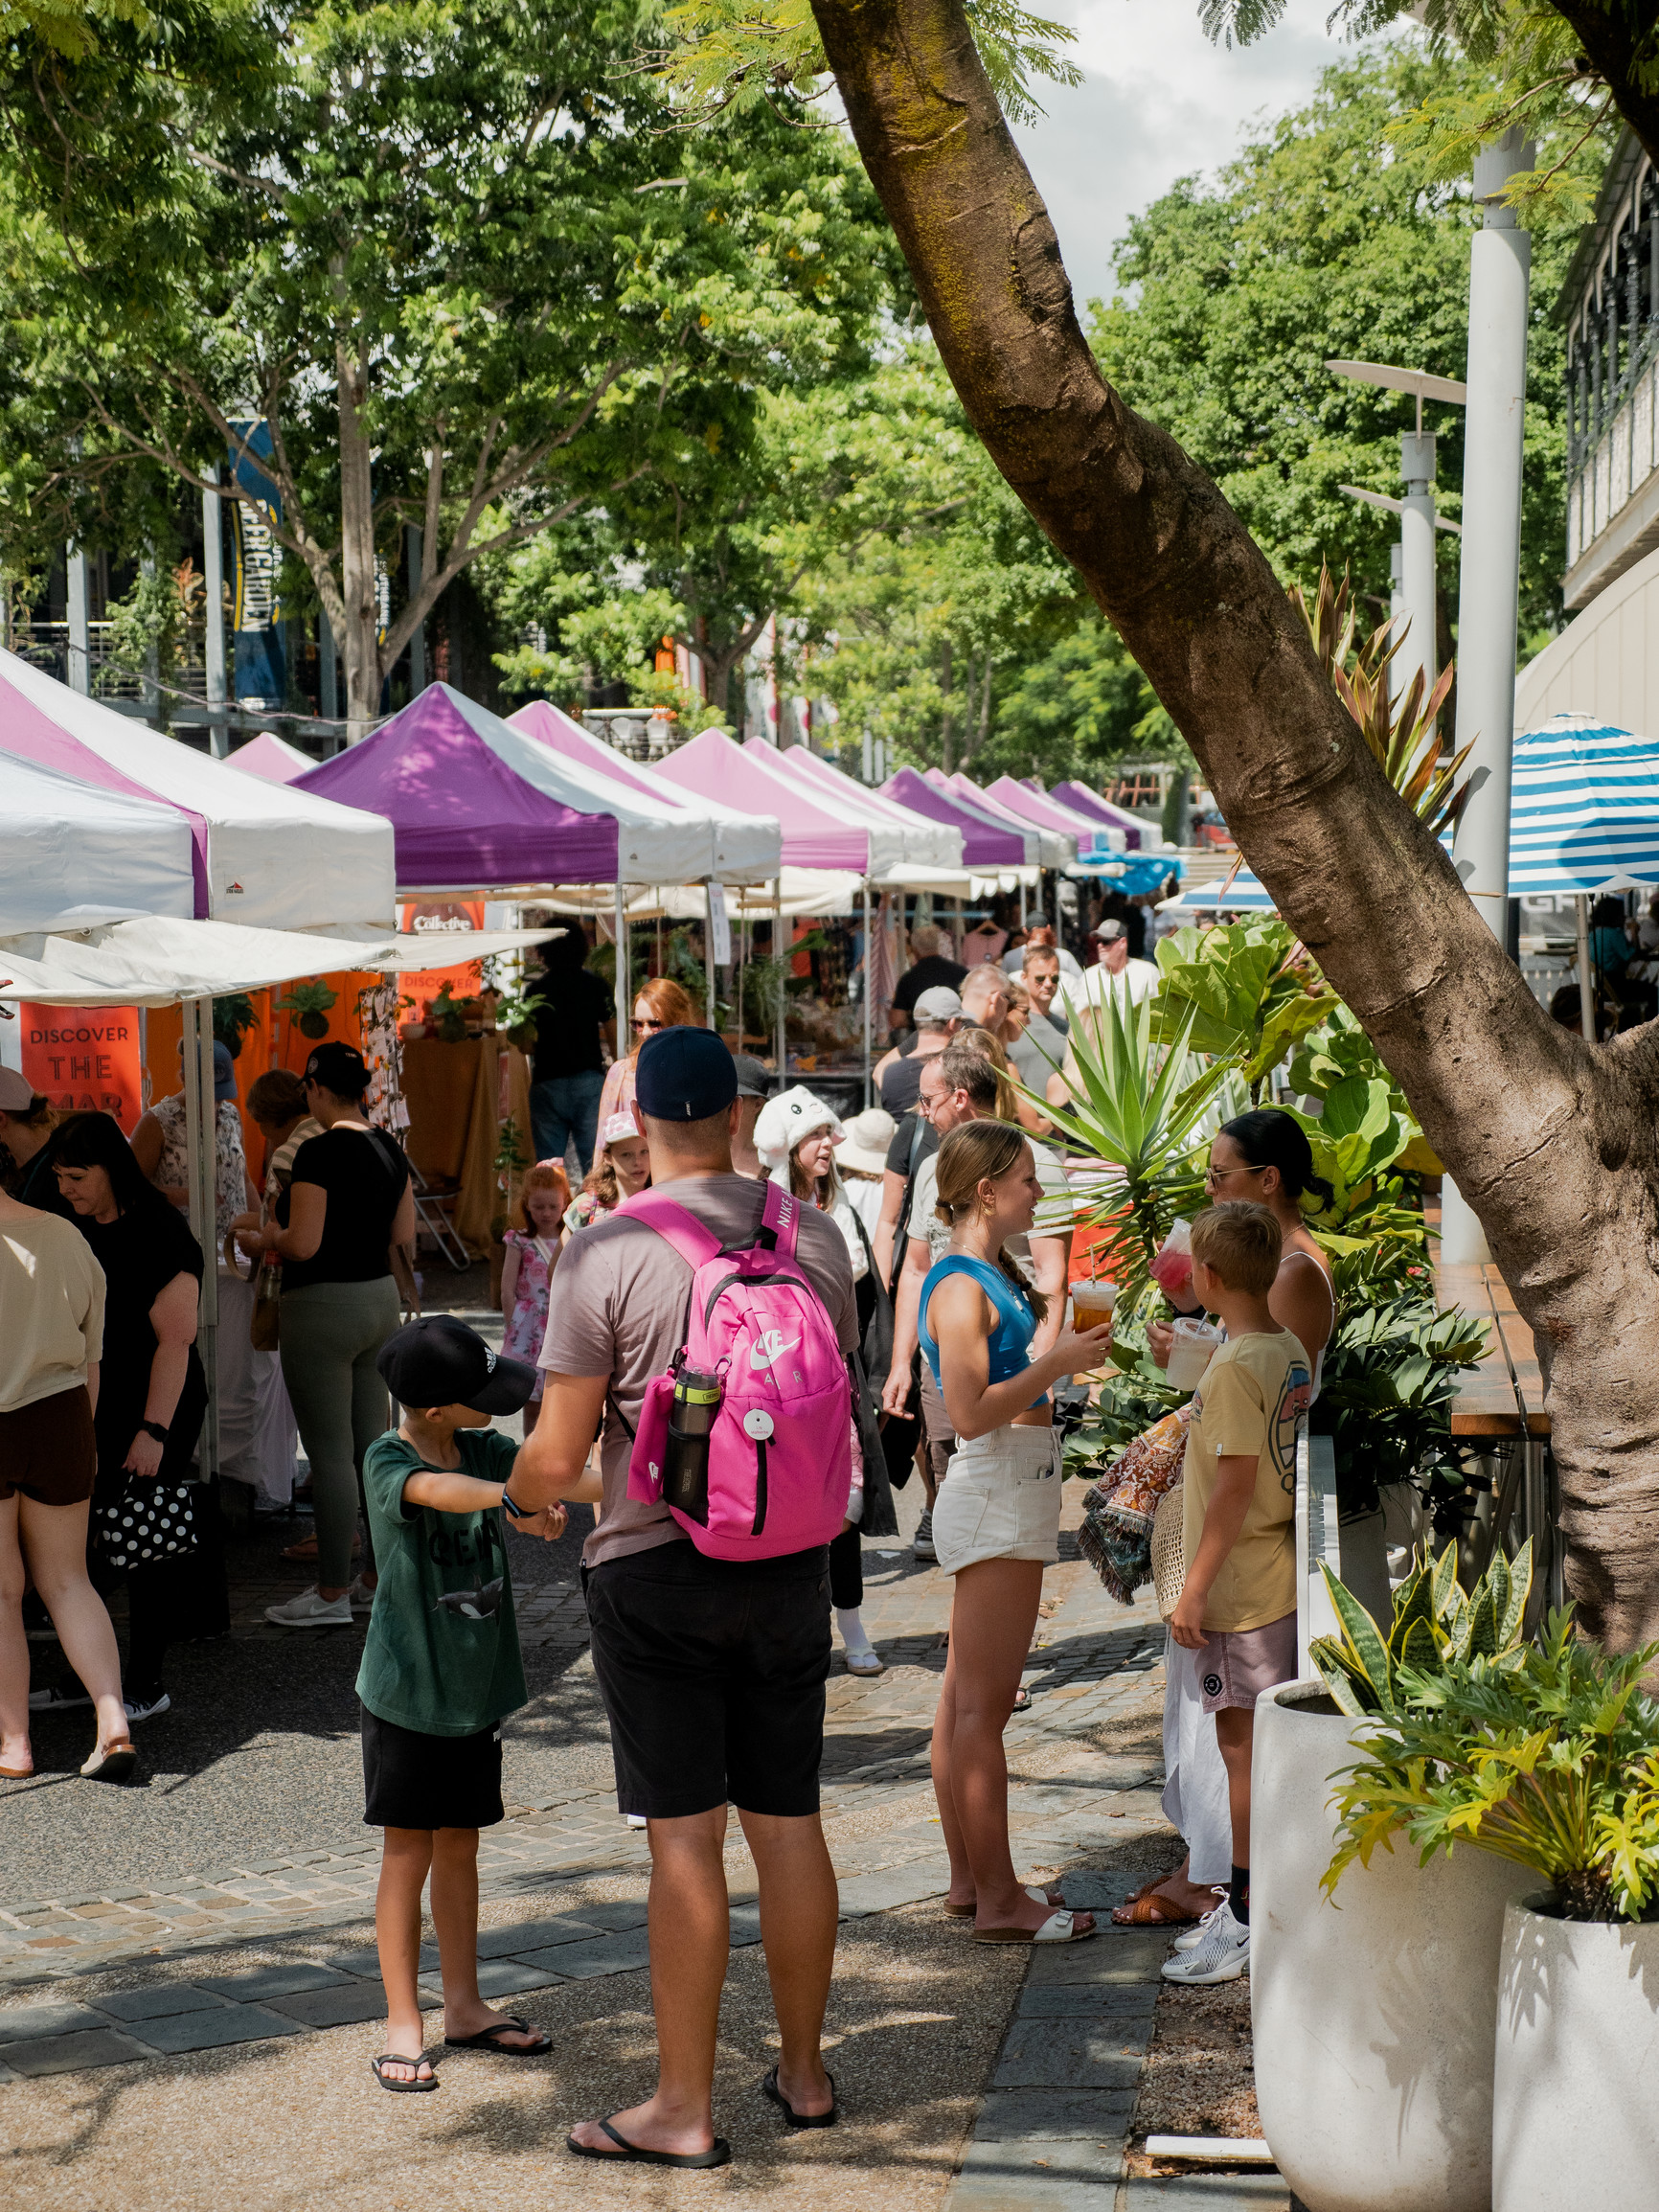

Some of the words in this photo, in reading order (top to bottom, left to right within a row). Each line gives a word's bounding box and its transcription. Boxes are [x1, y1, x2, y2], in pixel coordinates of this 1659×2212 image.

[241, 551, 272, 632] GARDEN
[414, 915, 472, 931] Collective
[404, 976, 473, 989] DISCOER
[30, 1027, 128, 1044] DISCOVER
[48, 1055, 112, 1080] THE
[777, 1197, 793, 1229] NIKE
[763, 1370, 803, 1390] AIR
